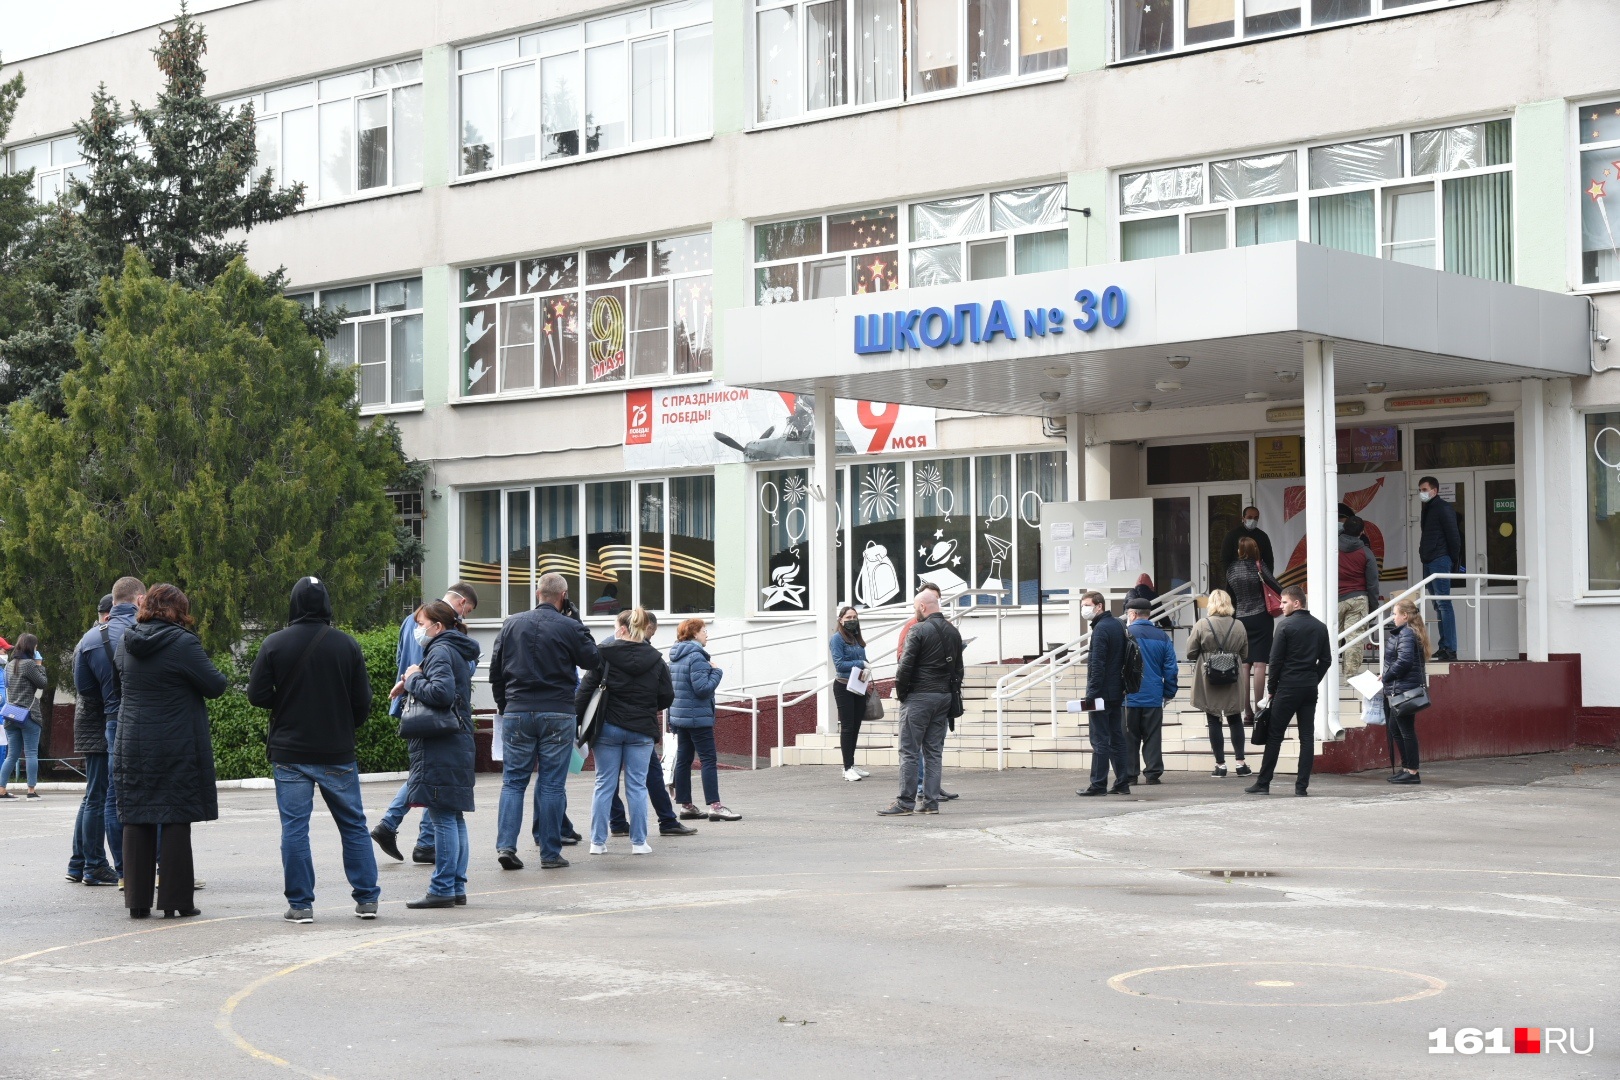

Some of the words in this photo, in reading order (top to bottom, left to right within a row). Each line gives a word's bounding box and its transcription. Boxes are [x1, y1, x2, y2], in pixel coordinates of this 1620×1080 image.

[589, 294, 624, 365] 9
[854, 299, 1016, 354] ШКОЛА
[1024, 307, 1063, 338] №
[1073, 285, 1128, 332] 30
[592, 349, 625, 380] МАЯ
[661, 396, 669, 408] С
[671, 389, 749, 407] ПРАЗДНИКОМ
[661, 409, 711, 425] ПОБЕДЫ!
[857, 399, 900, 453] 9
[891, 435, 927, 450] мая
